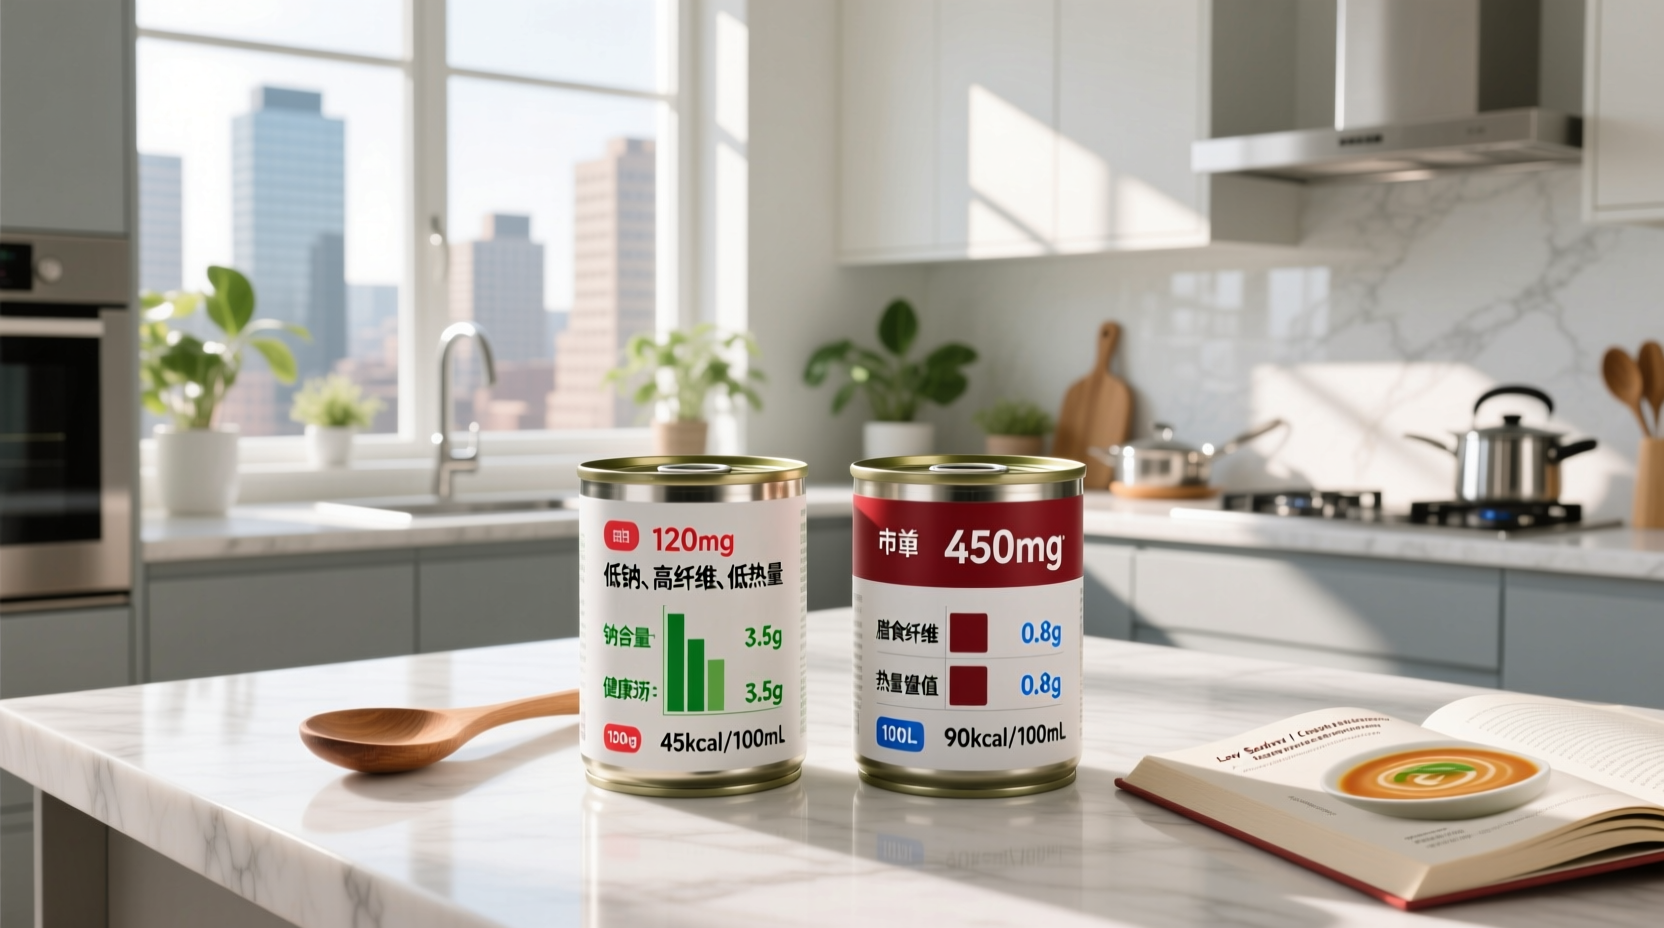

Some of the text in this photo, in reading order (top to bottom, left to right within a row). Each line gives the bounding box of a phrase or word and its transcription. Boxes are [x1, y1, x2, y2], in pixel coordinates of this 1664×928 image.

[652, 527, 734, 557] 120mg
[944, 529, 1062, 571] 450mg
[604, 562, 784, 591] 低钠、高纤维、低热量
[745, 625, 782, 650] 3.5g
[1021, 620, 1062, 647] 0.8g
[745, 680, 783, 706] 3.5g
[1021, 672, 1061, 699] 0.8g
[660, 724, 785, 754] 45kcal/100mL
[881, 724, 918, 745] 100L
[944, 721, 1066, 749] 90kcal/100mL
